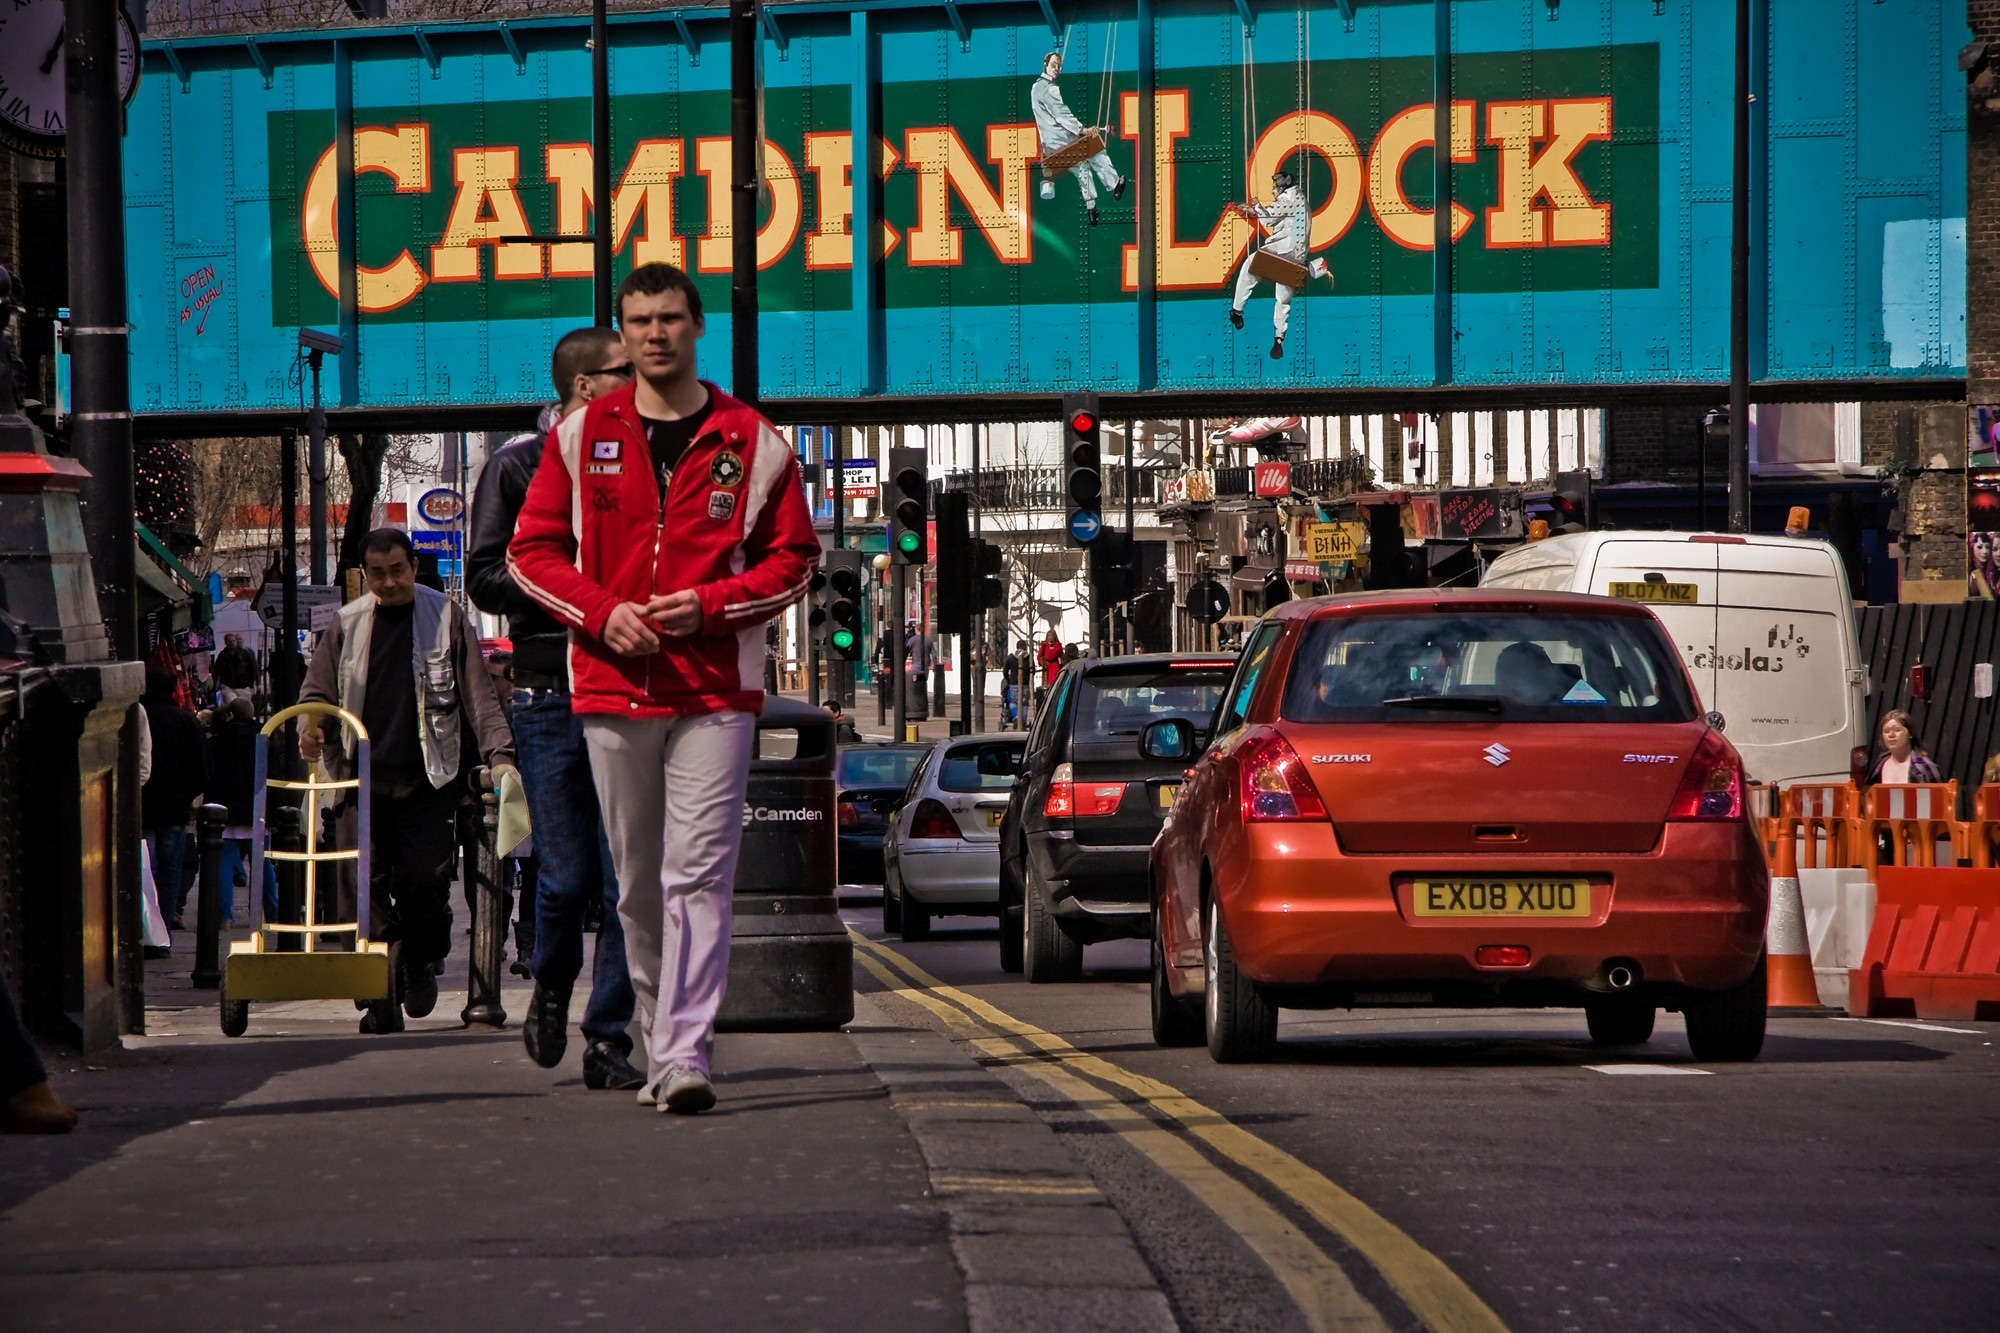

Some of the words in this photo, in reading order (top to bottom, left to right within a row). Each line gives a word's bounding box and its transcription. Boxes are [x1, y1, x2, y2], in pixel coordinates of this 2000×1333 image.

[302, 122, 1040, 312] CAMDEN
[1120, 88, 1612, 292] LOCK
[181, 263, 216, 298] OPEN
[180, 306, 193, 326] AS
[193, 280, 224, 311] USUAL!
[851, 475, 872, 484] LET
[1260, 468, 1288, 492] illy
[1615, 583, 1656, 599] BL07
[1659, 584, 1691, 600] YNZ
[1311, 753, 1372, 765] SUZUKI
[1623, 753, 1679, 765] SWIFT
[754, 806, 823, 822] Camden
[1427, 882, 1507, 910] EX08
[1517, 882, 1577, 910] XUO
